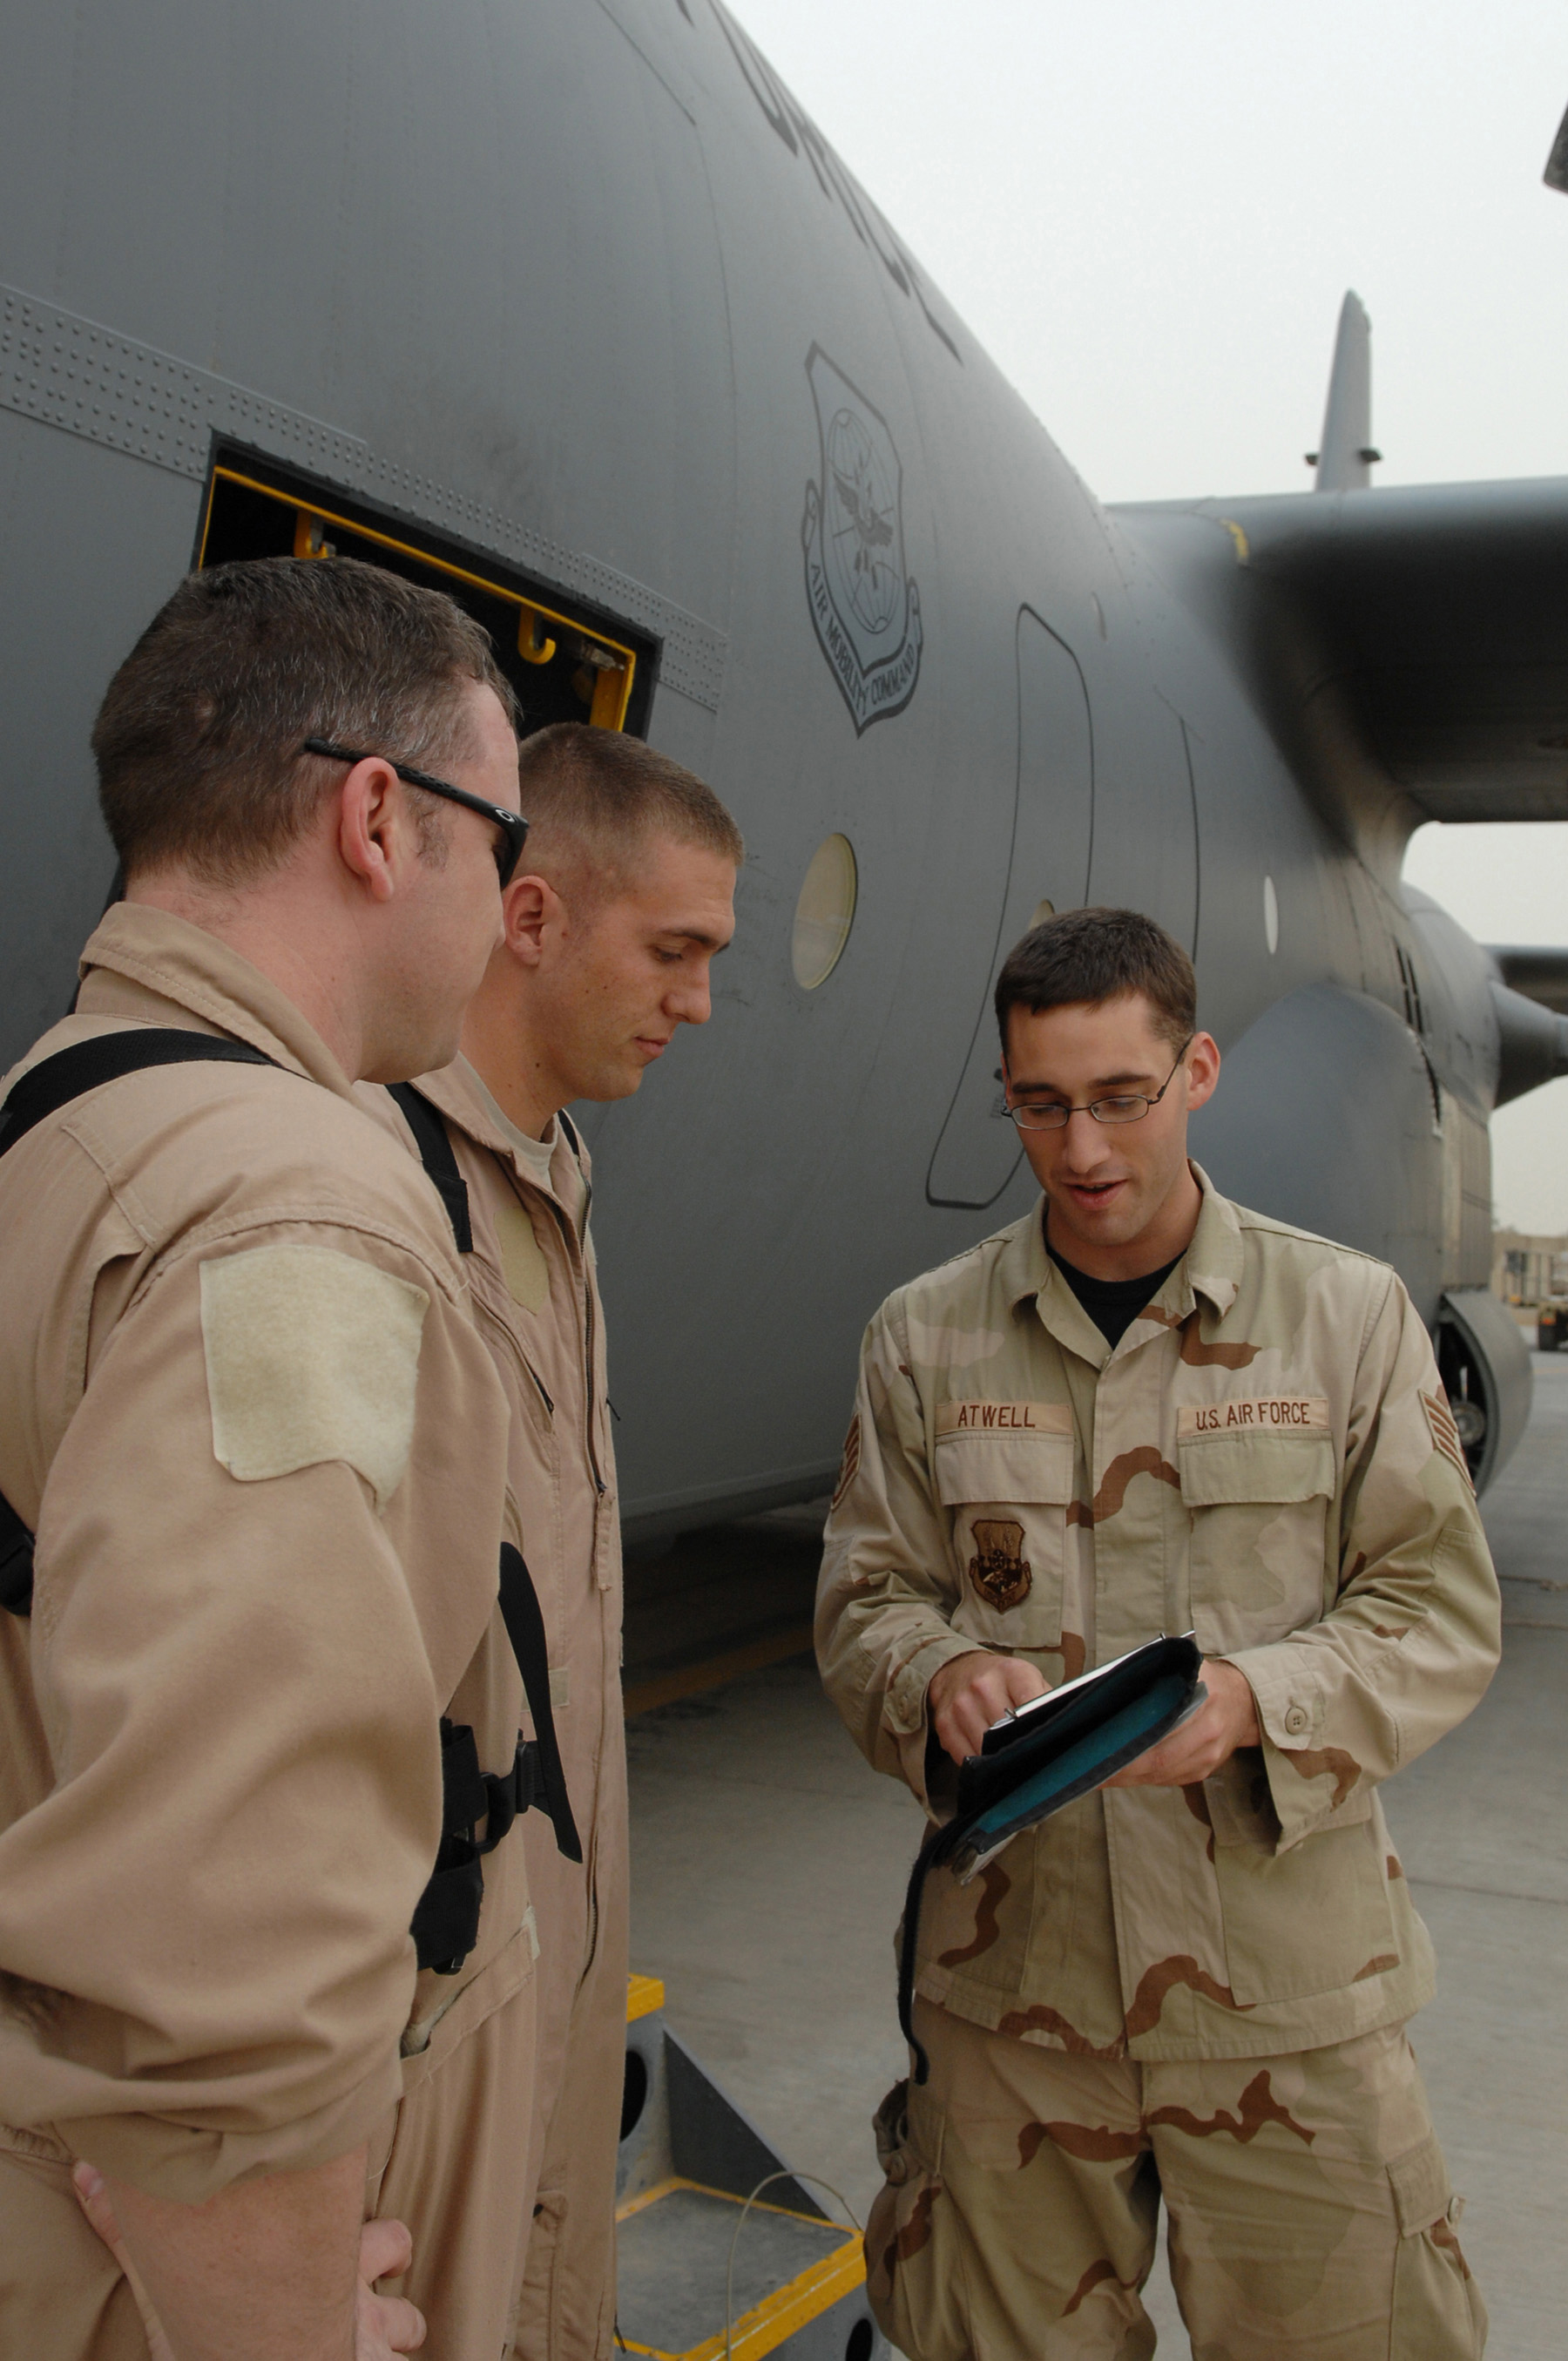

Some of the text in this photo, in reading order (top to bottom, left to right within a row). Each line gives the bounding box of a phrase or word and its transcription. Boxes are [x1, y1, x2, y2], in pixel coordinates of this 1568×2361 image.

[811, 565, 915, 716] AIR MOBILITY COMMAND
[958, 1404, 1036, 1428] ATWELL
[1196, 1402, 1310, 1431] U.S. AIR FORCE
